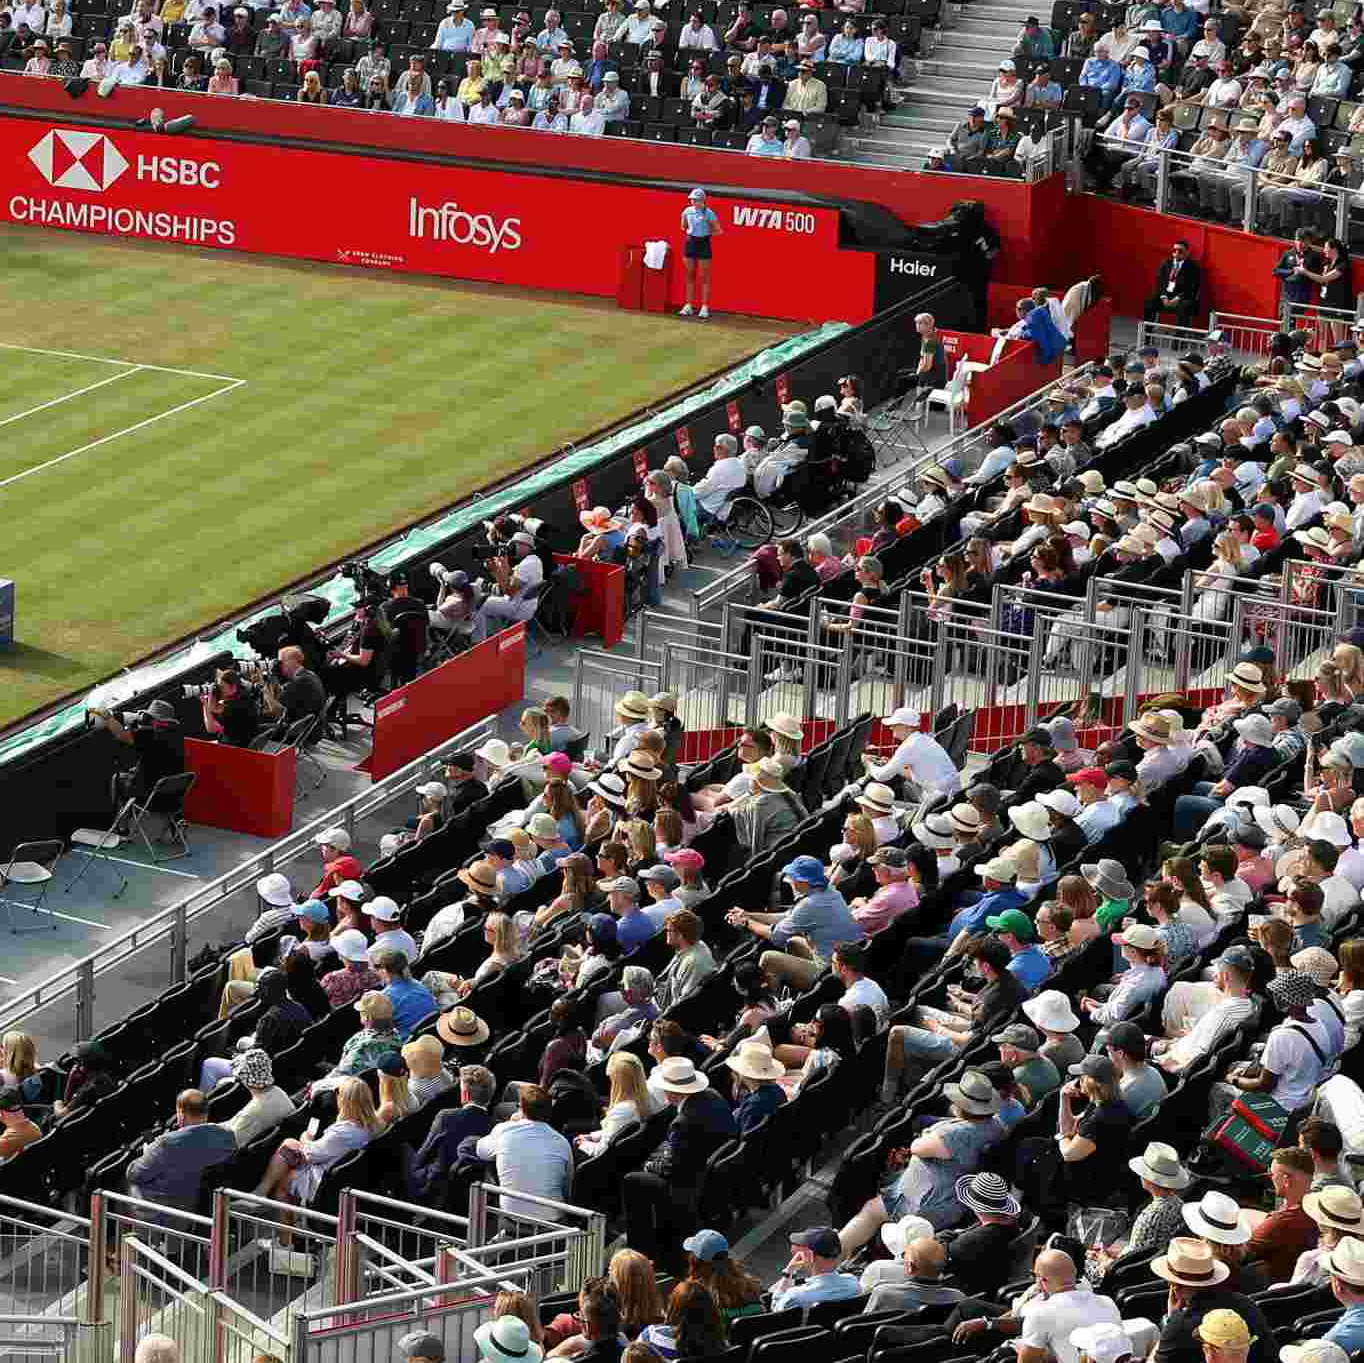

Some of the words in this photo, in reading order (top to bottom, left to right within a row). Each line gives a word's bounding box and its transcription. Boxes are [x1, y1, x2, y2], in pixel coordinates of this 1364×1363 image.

[137, 154, 221, 189] HSBC
[9, 195, 236, 245] CHAMPIONSHIPS
[408, 197, 521, 254] Infosys
[733, 206, 782, 231] WTA
[785, 211, 815, 234] 500
[890, 257, 936, 277] Haier
